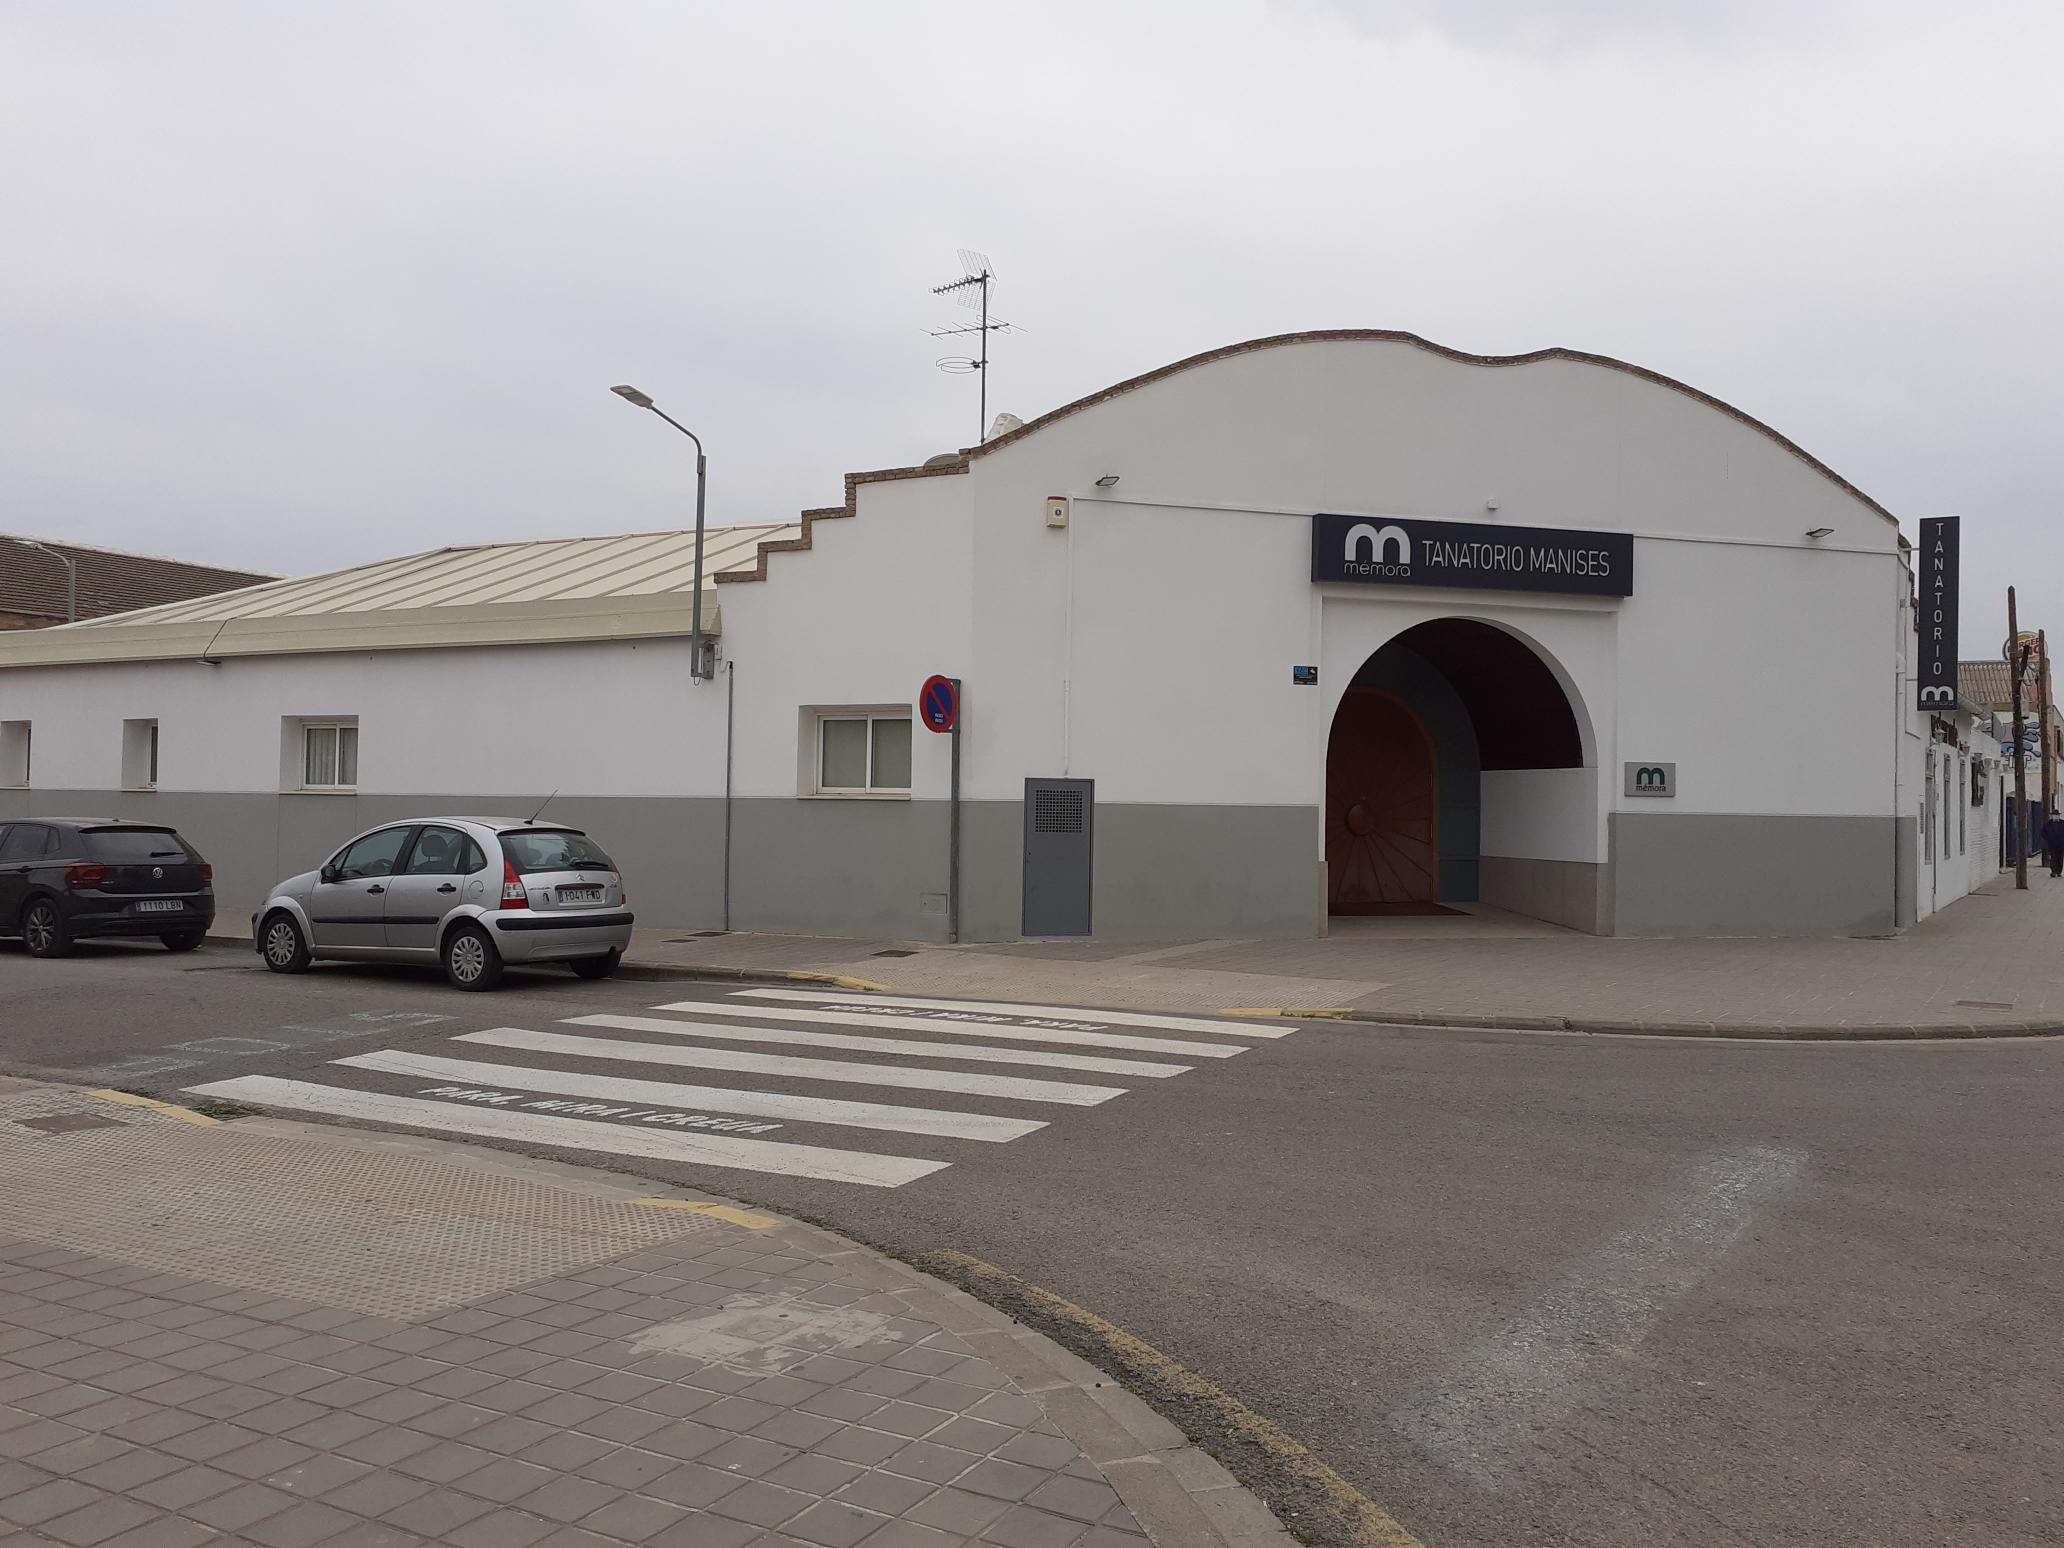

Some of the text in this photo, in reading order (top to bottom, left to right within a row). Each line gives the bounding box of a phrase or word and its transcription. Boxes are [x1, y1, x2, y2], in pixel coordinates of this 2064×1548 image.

[1344, 560, 1411, 577] mémora
[1422, 540, 1611, 577] TANATORIO MANISES
[1933, 522, 1945, 675] TANATORIO
[519, 1100, 631, 1117] MIRA
[641, 1110, 784, 1134] CREUA
